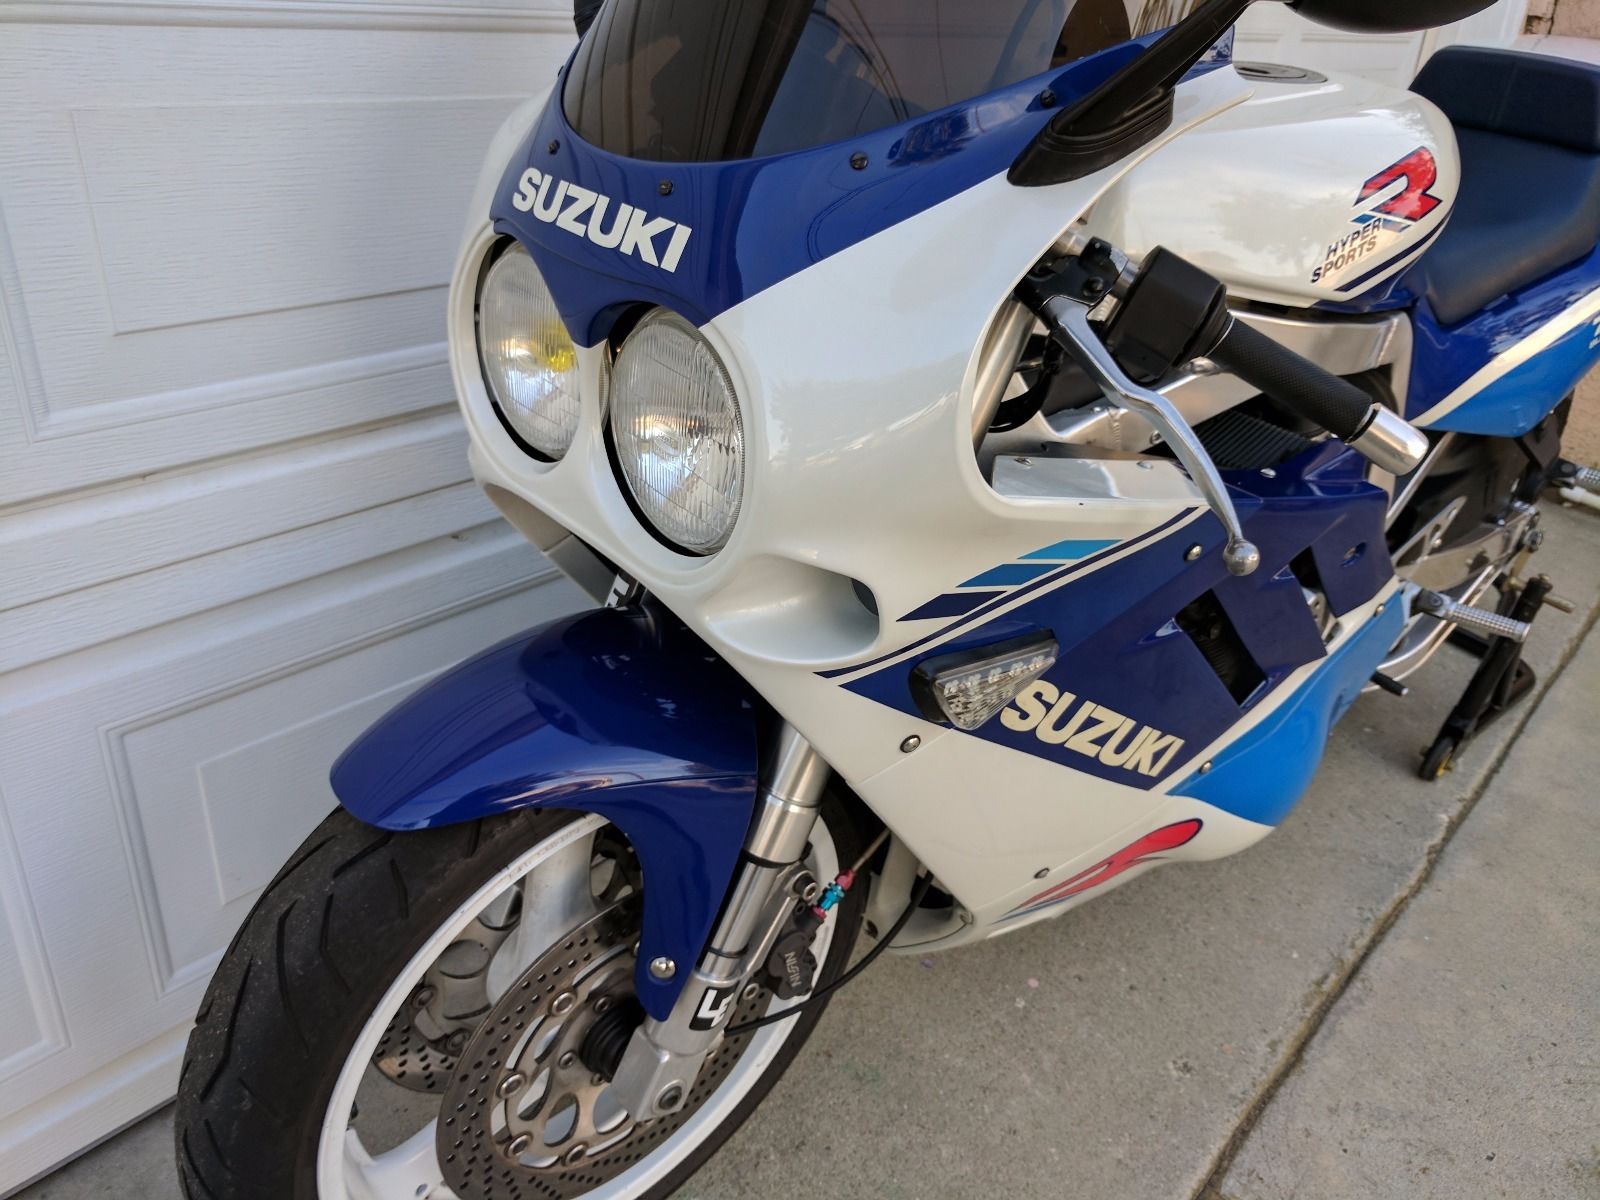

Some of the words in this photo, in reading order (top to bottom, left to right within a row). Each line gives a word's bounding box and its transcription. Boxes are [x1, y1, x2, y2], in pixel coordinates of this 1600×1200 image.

[512, 167, 692, 273] SUZUKI
[1326, 217, 1382, 260] HYPER
[1311, 235, 1377, 283] SPORTS
[1000, 679, 1185, 777] SUZUKI
